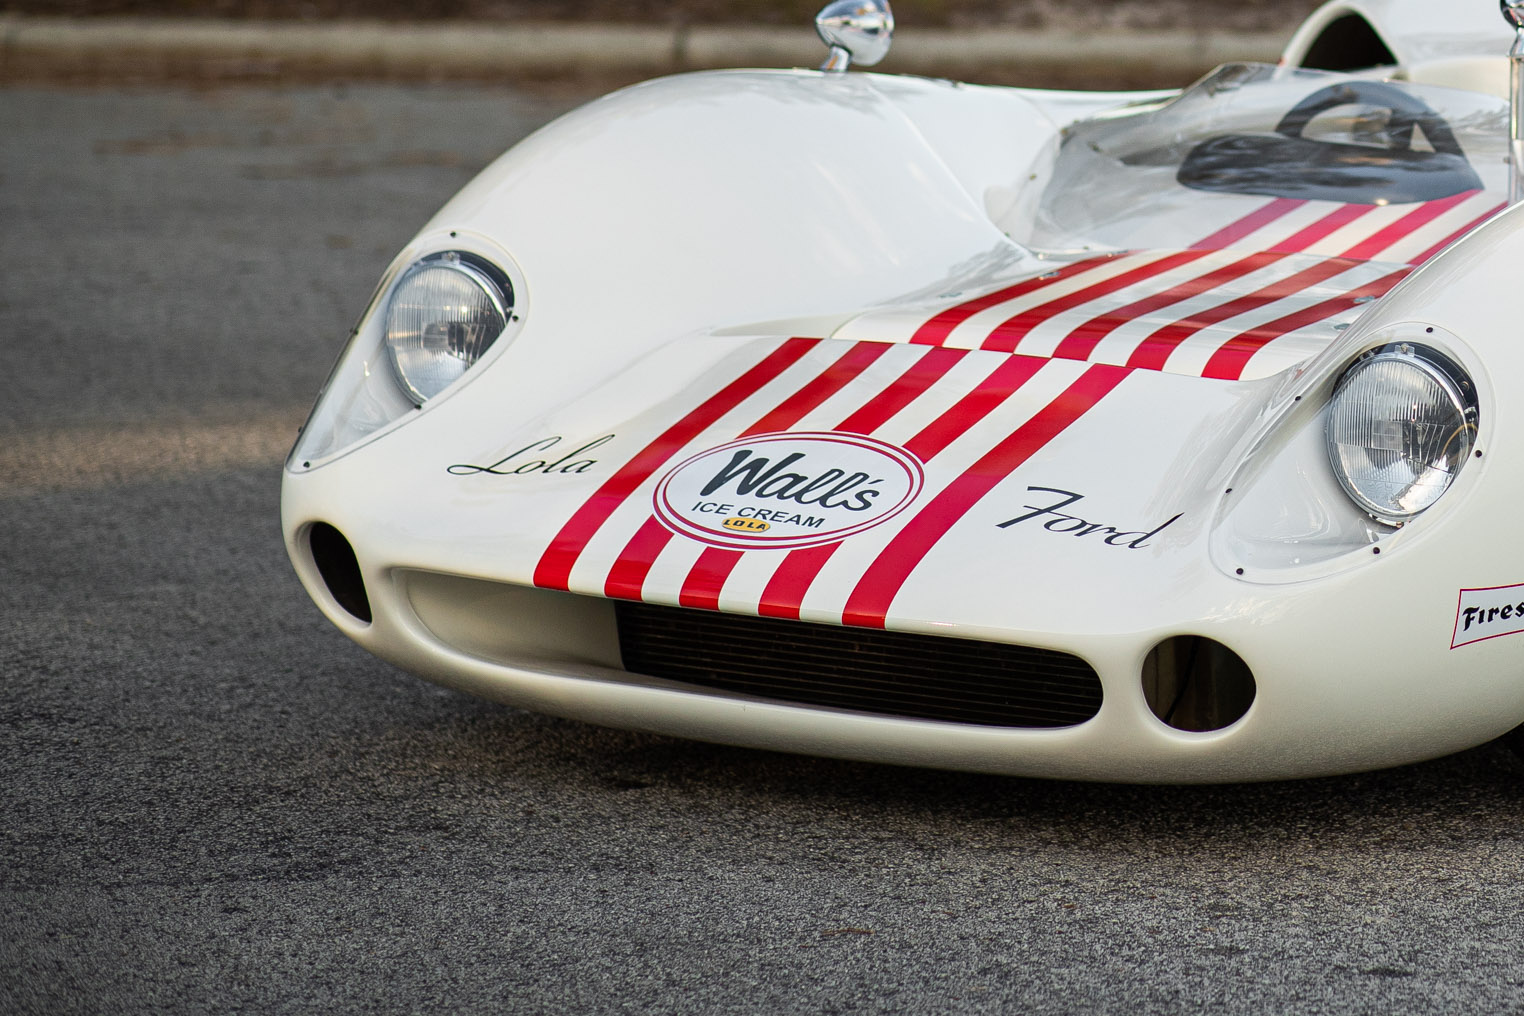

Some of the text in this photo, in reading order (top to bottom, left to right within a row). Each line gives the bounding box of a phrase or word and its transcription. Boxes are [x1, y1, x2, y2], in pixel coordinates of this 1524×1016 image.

[447, 434, 615, 475] Lola
[700, 449, 885, 511] Wall's
[691, 501, 826, 529] ICE CREAM
[723, 519, 767, 530] LOLA
[995, 486, 1185, 549] Ford
